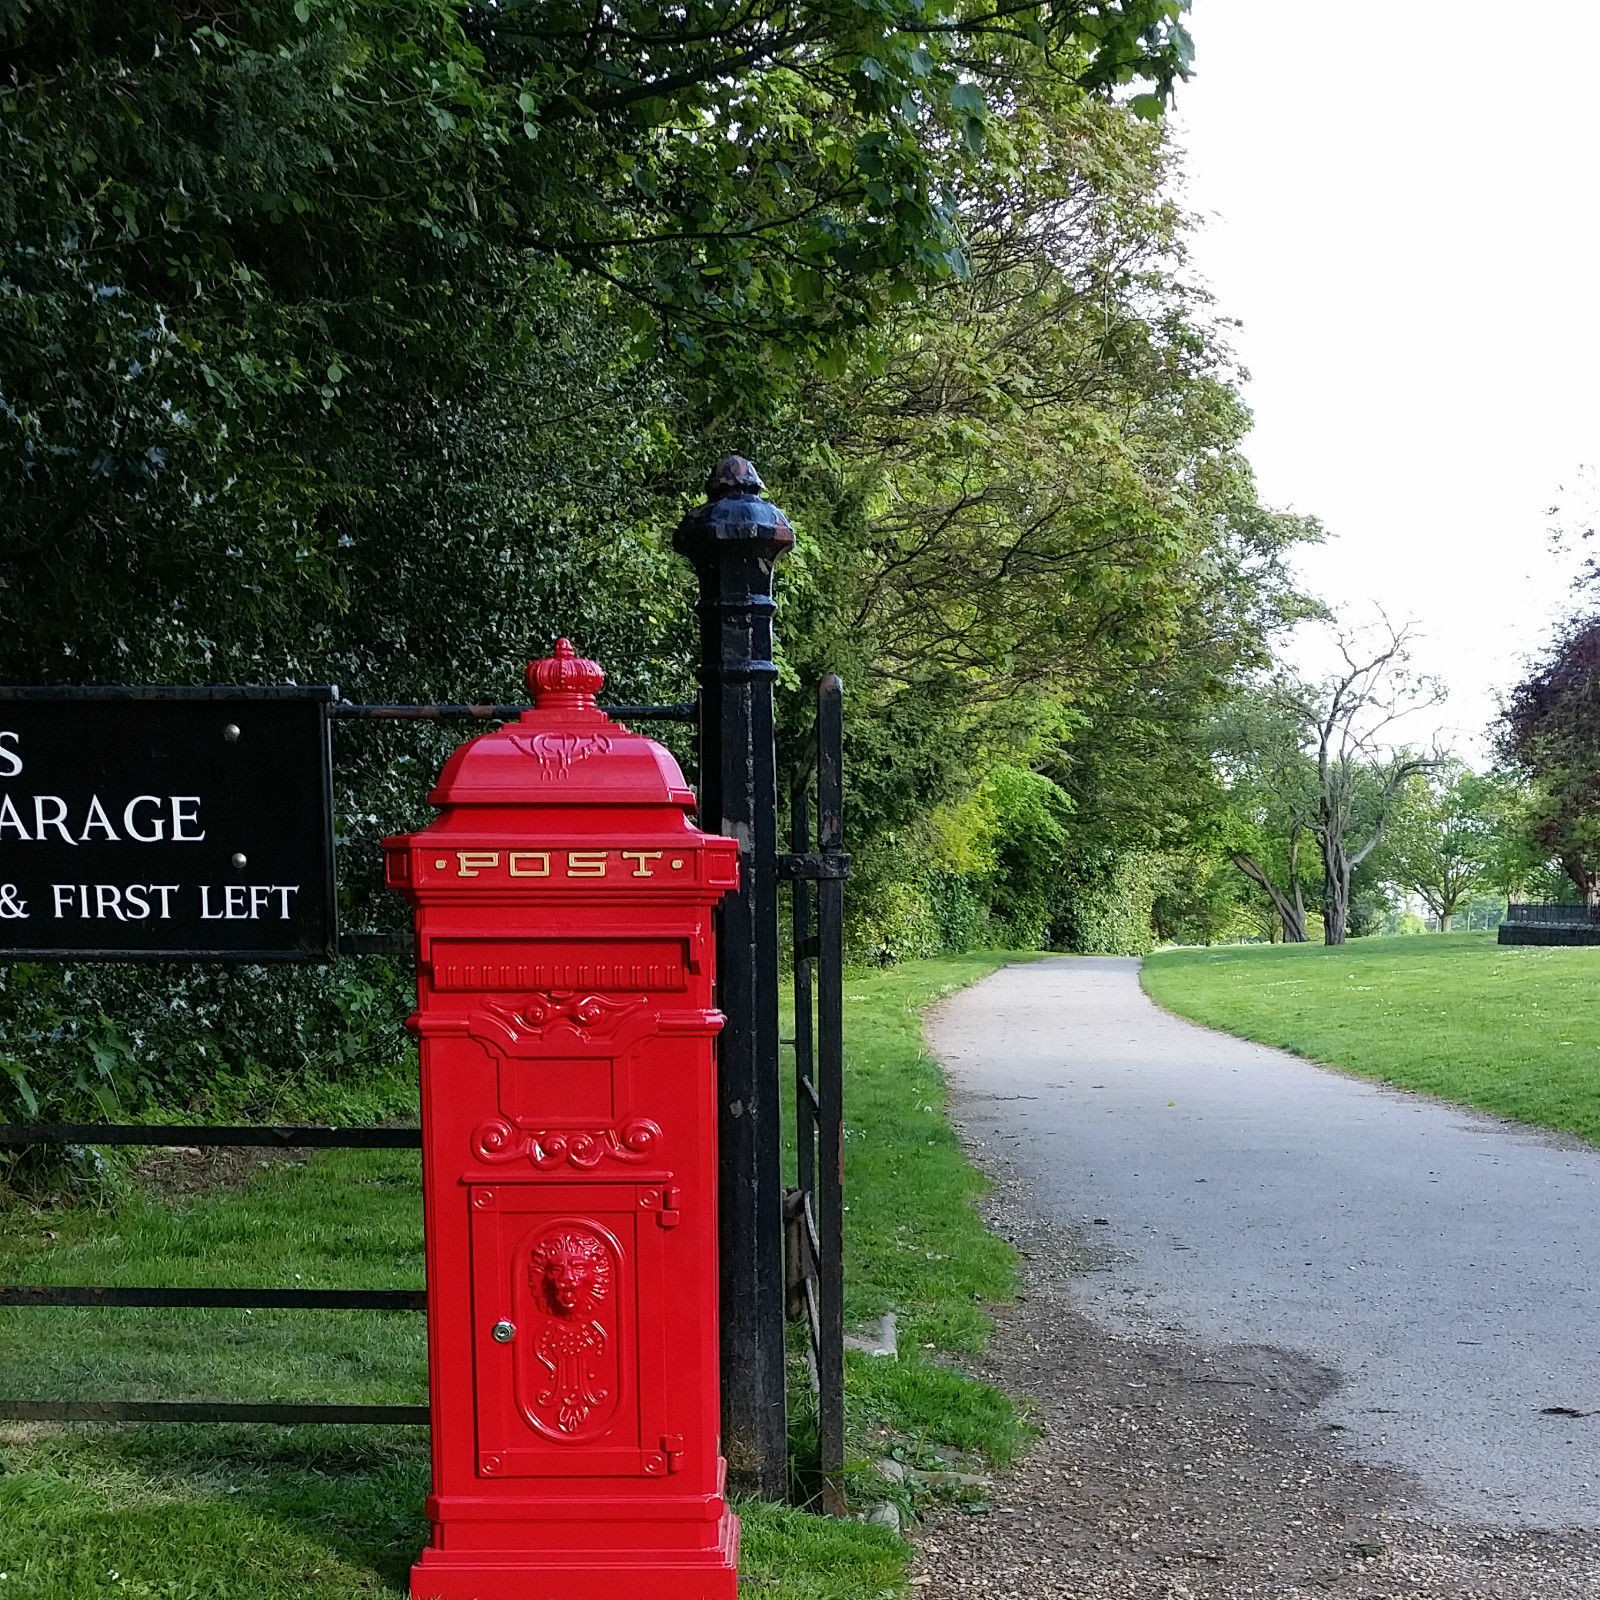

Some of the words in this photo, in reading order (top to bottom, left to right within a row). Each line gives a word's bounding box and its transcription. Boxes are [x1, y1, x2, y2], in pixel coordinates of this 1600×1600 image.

[0, 793, 206, 846] ARAGE
[456, 851, 663, 877] POST
[0, 883, 30, 919] &
[51, 884, 180, 921] FIRST
[199, 884, 300, 919] LEFT
